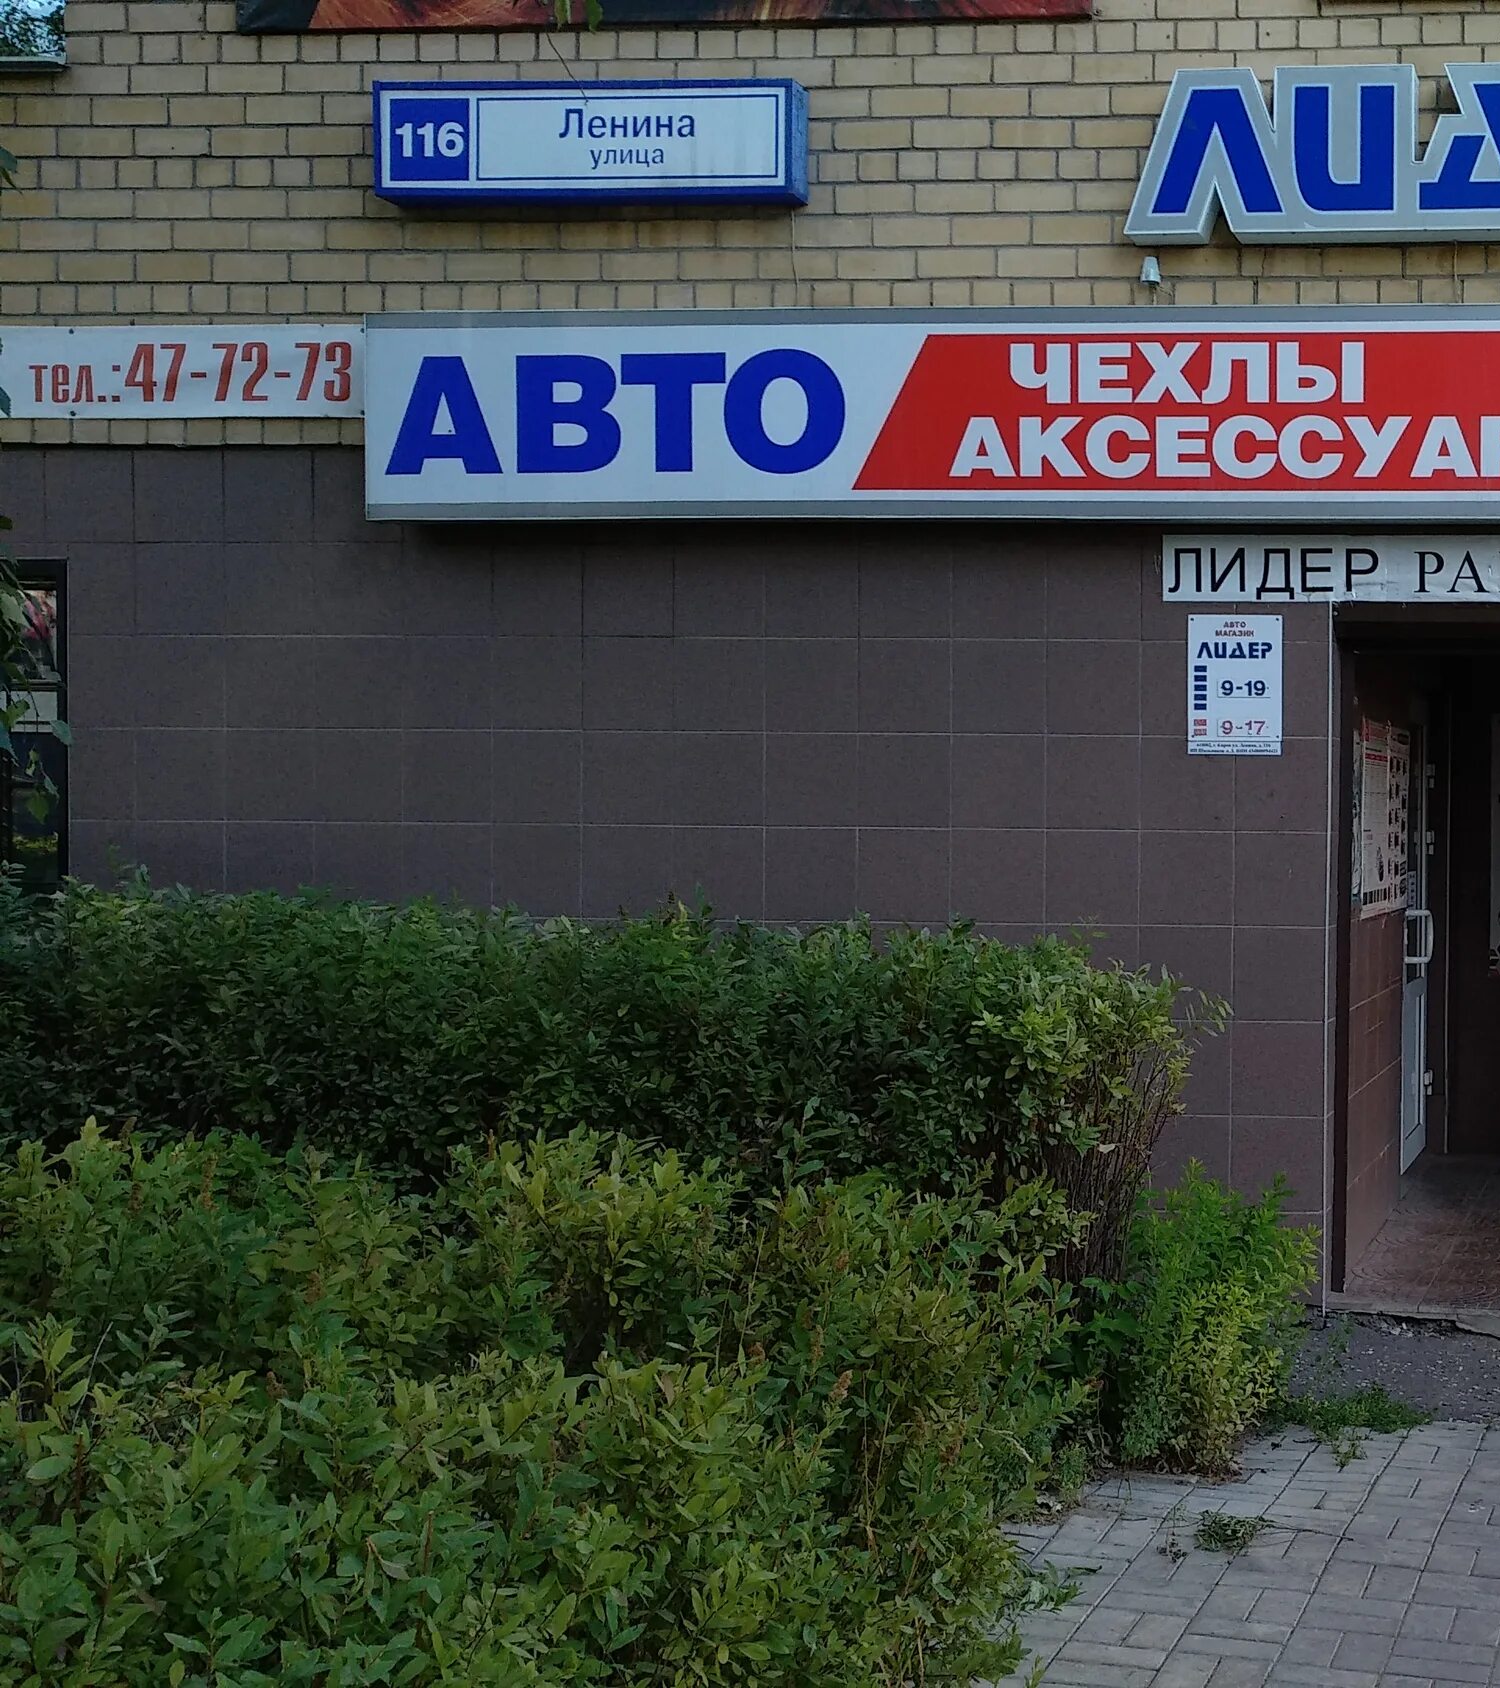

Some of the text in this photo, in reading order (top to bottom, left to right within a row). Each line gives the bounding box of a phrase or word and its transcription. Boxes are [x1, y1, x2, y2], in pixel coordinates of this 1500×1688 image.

[559, 108, 696, 139] Ленина
[394, 121, 465, 158] 116
[589, 146, 665, 170] улица
[1009, 341, 1366, 404] ЧЕХЛЫ
[384, 348, 847, 476] АВТО
[1167, 547, 1379, 600] ЛИДЕР
[1196, 641, 1273, 659] ЛИДЕР
[1220, 680, 1267, 696] 9-19
[1220, 720, 1266, 735] 9-17
